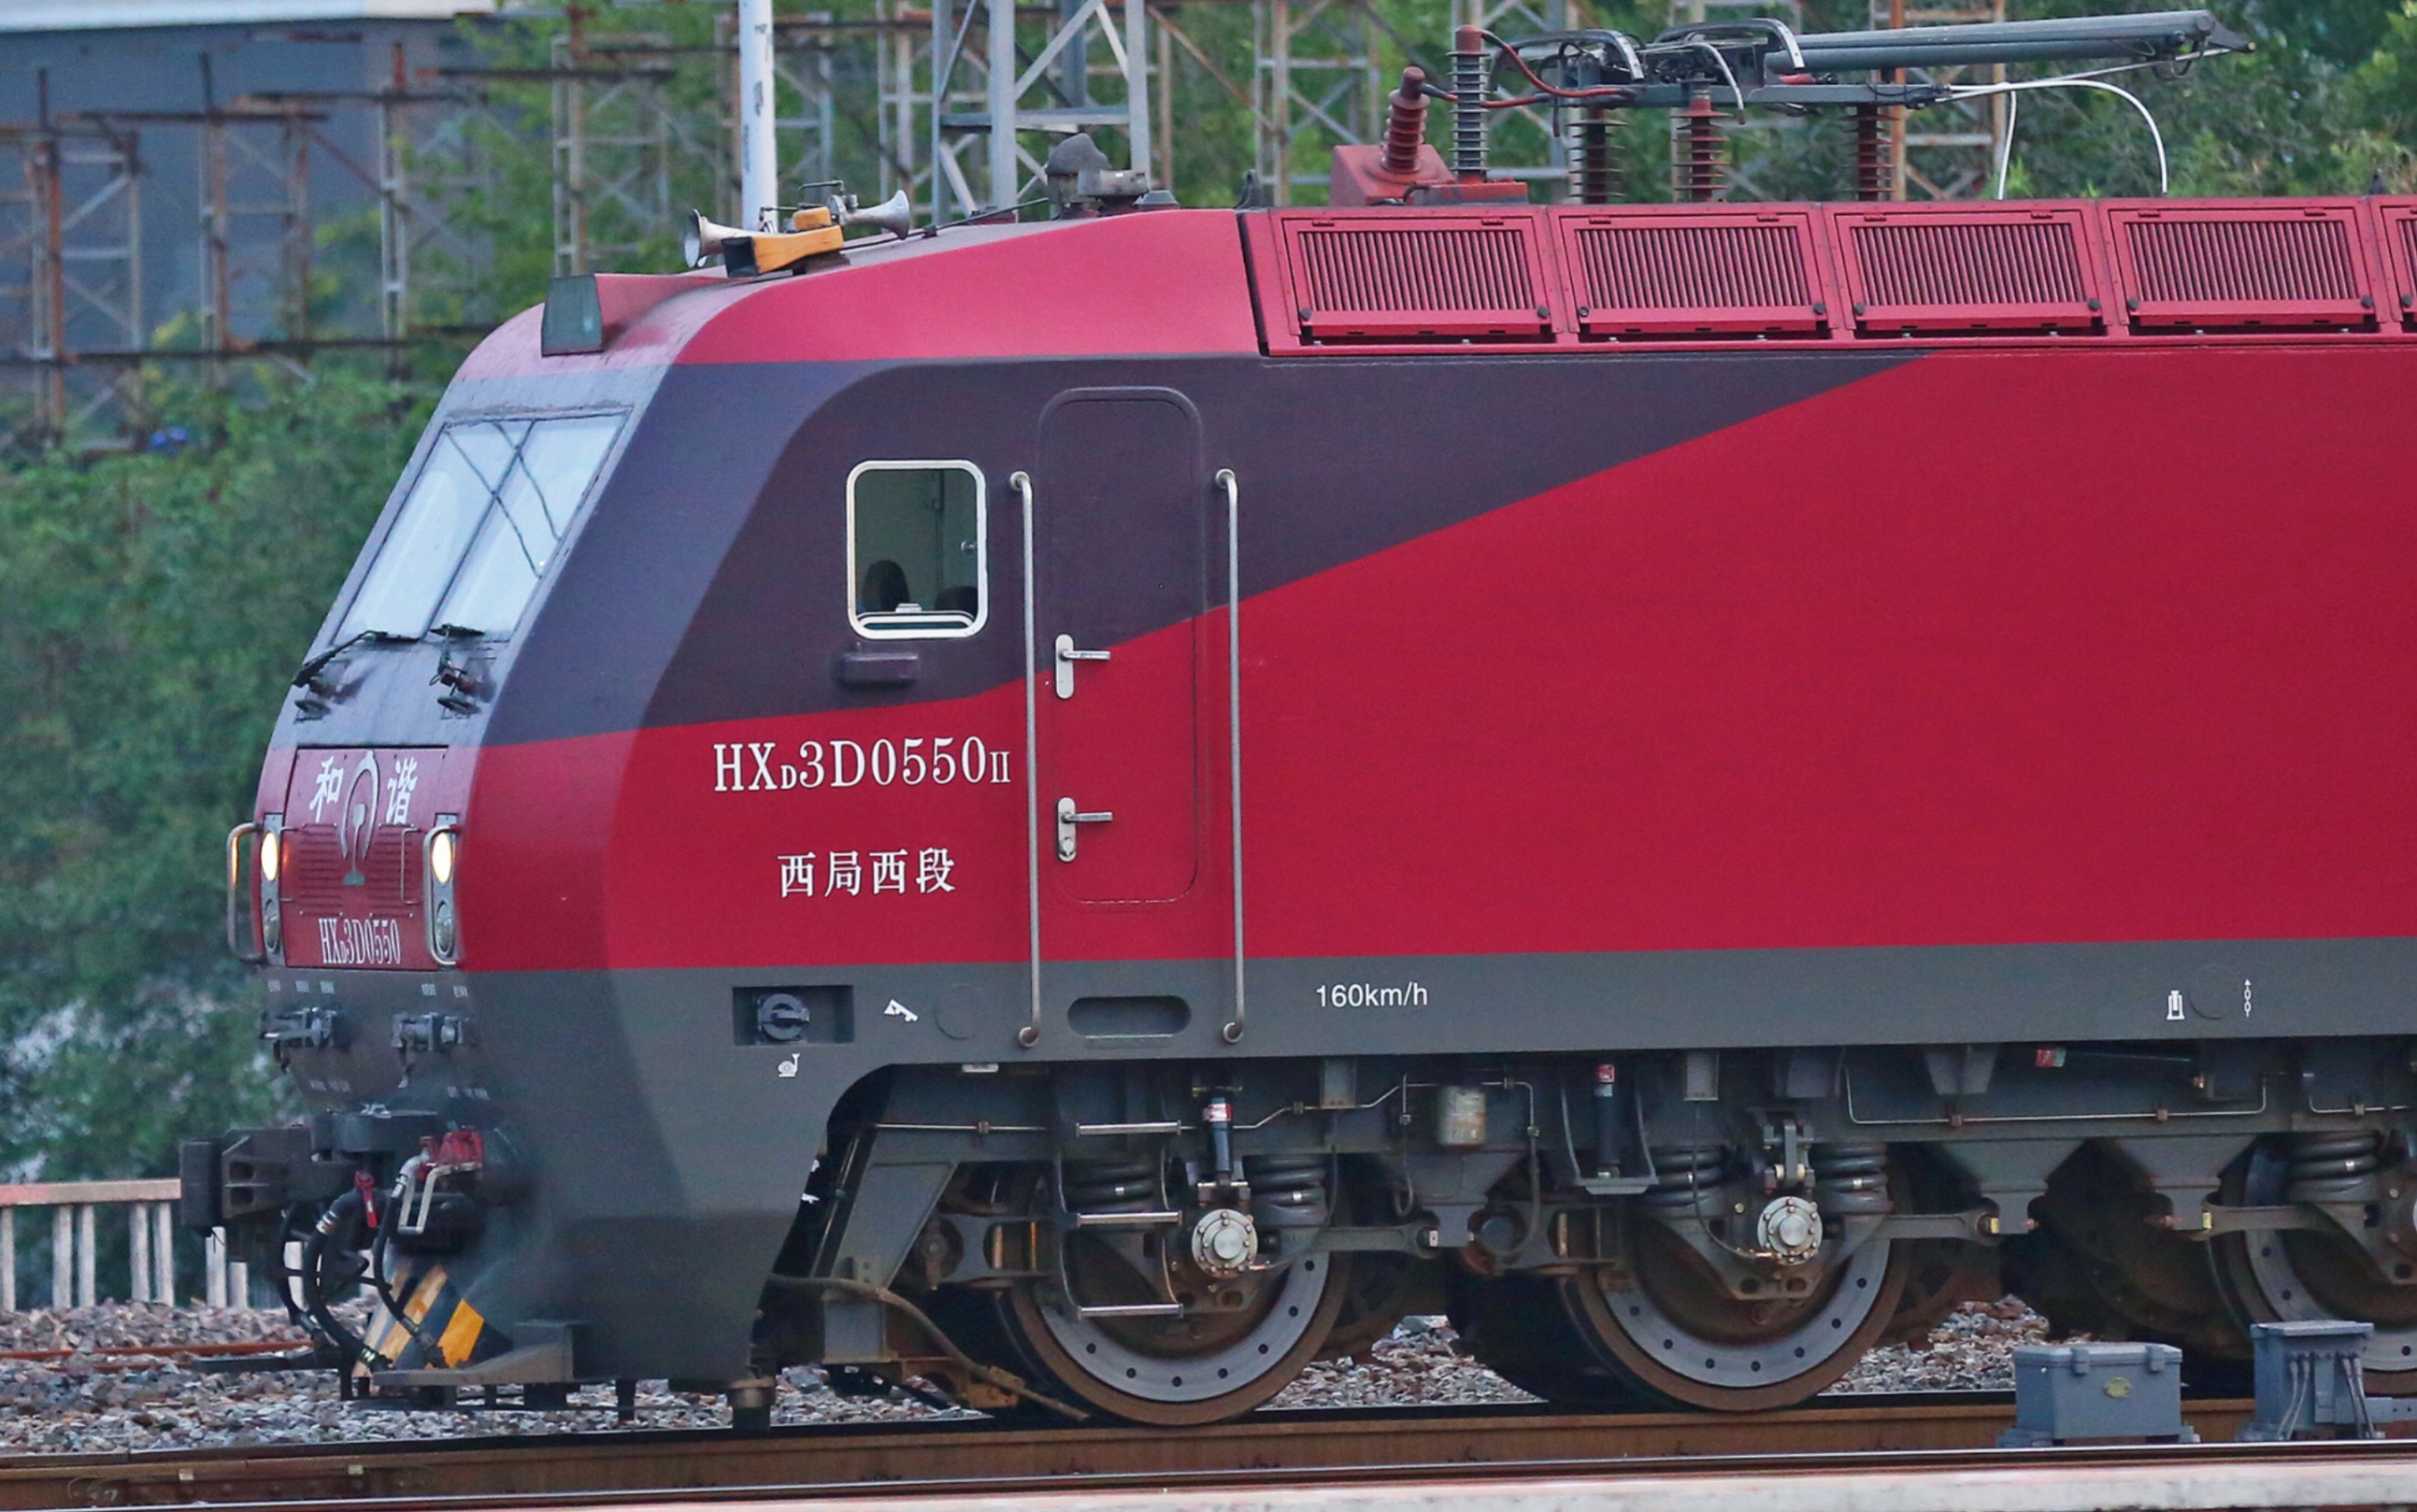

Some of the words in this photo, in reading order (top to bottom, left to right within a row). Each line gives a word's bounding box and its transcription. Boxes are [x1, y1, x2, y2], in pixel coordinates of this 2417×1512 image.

[309, 755, 343, 822] 和
[777, 847, 956, 898] 西局西段
[319, 918, 401, 964] HXD3D0550
[1316, 981, 1428, 1007] 160km/h
